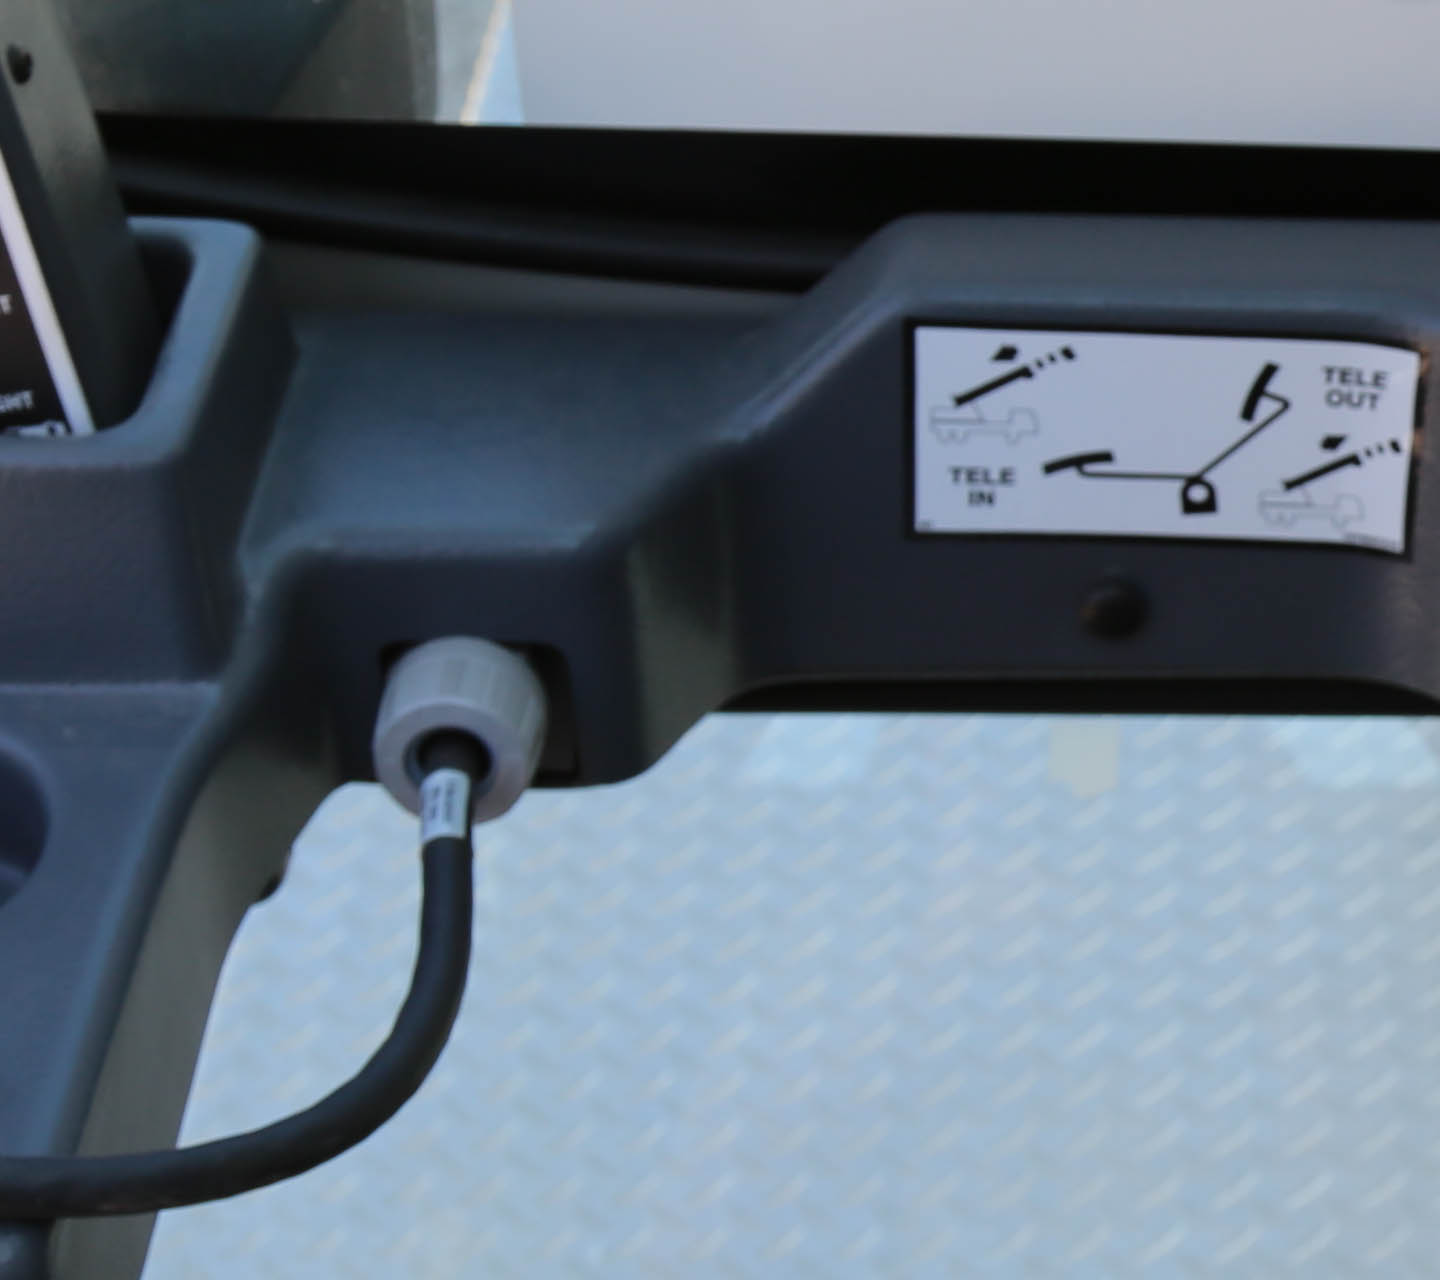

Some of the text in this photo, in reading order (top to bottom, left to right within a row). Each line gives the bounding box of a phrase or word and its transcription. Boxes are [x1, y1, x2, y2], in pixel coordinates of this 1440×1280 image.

[1322, 365, 1388, 390] TELE
[1325, 388, 1380, 410] OUT
[948, 465, 1016, 486] TELE
[967, 489, 996, 508] IN
